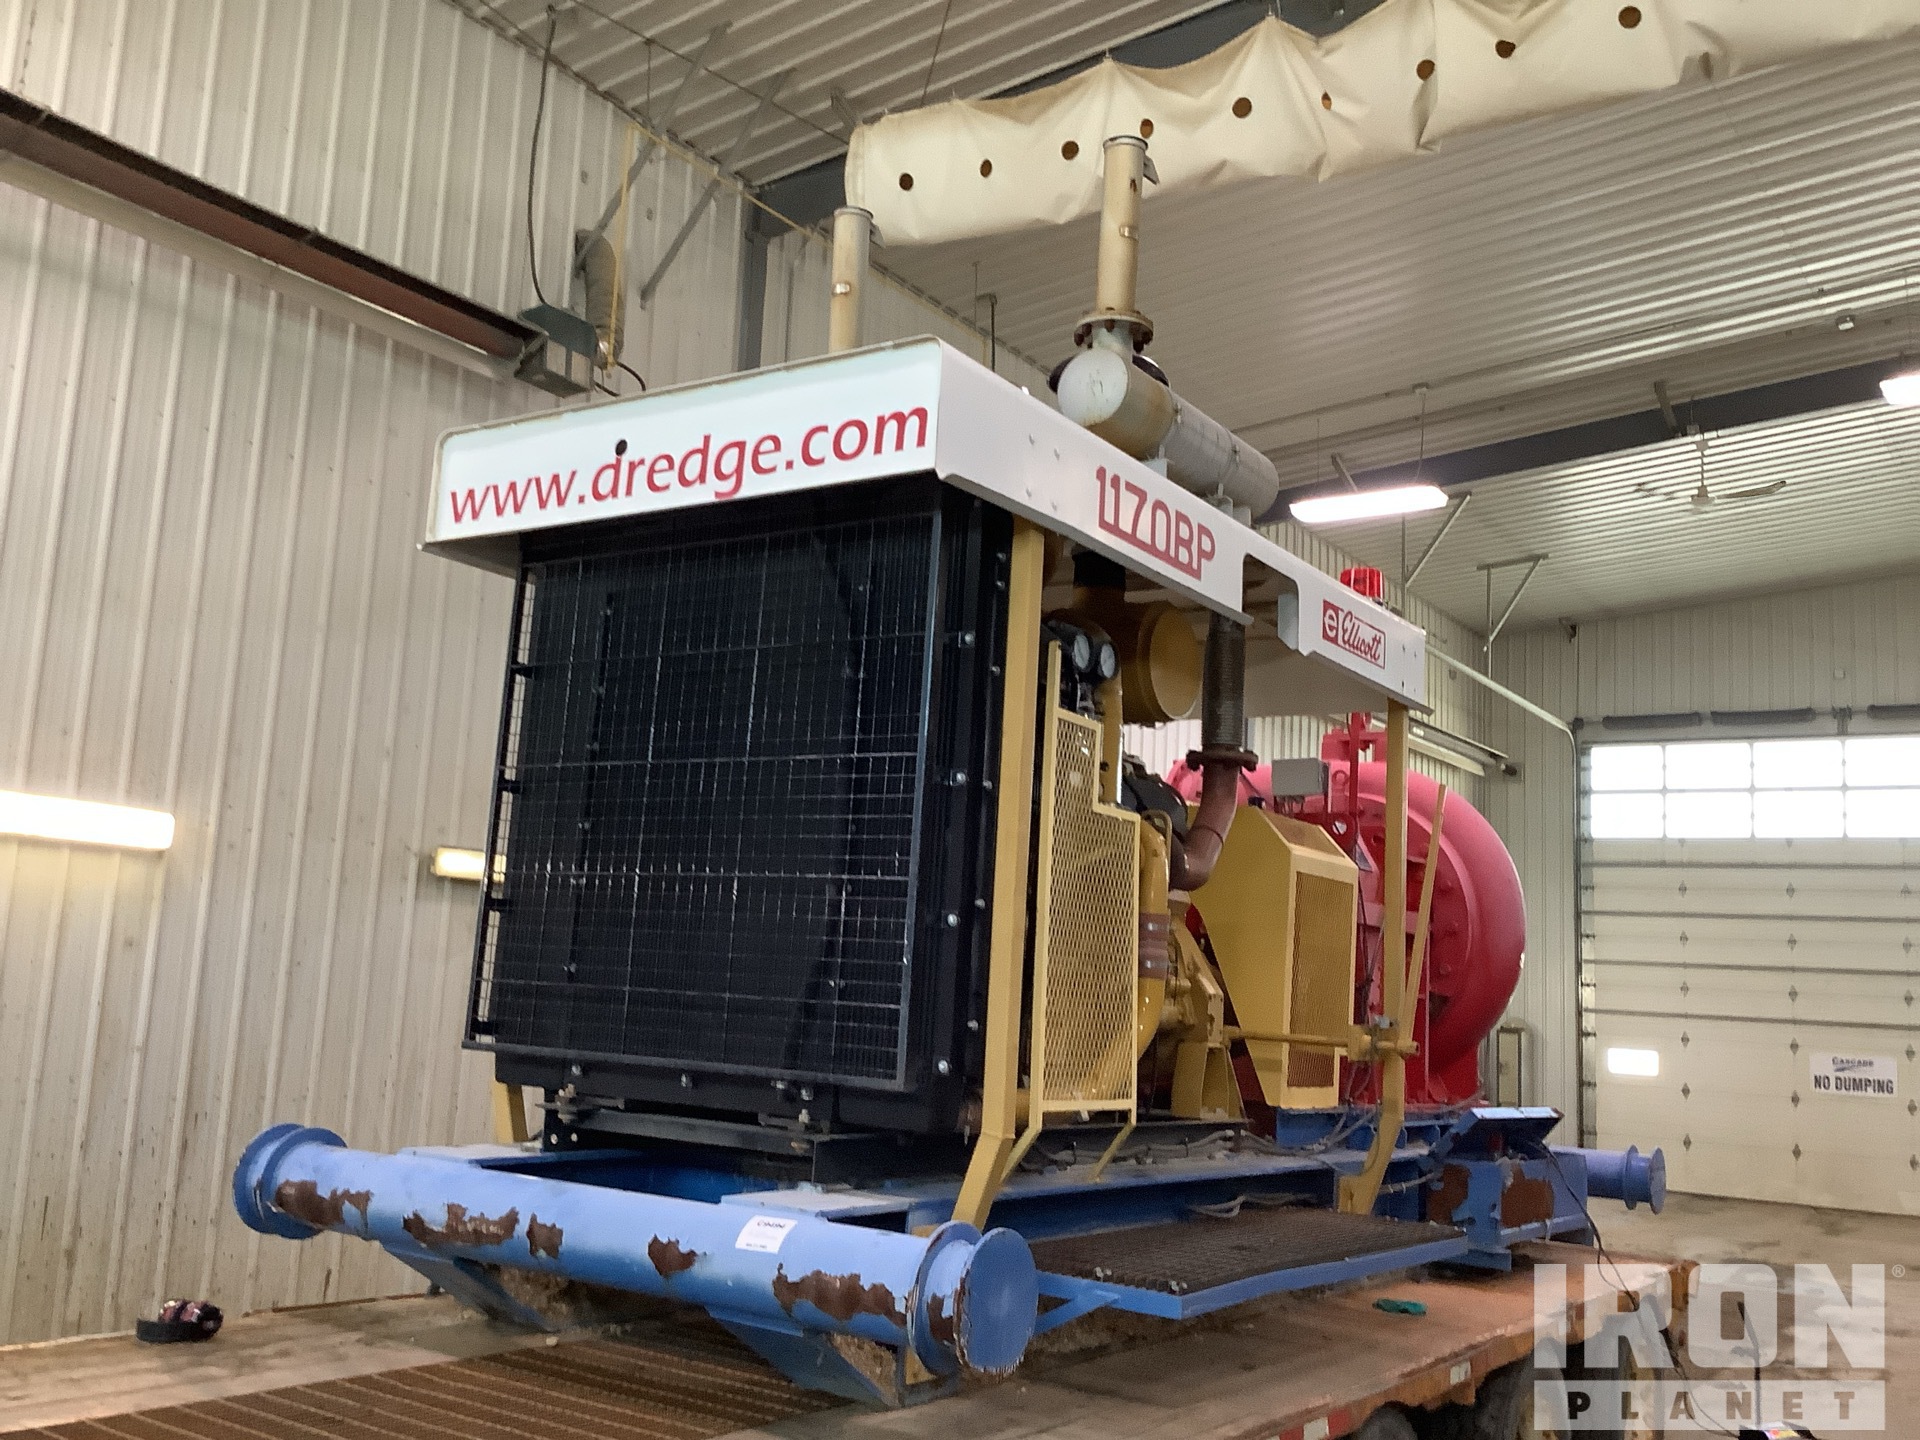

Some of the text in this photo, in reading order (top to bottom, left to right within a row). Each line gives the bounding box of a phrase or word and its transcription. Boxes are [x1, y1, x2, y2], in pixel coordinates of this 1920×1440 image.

[449, 406, 929, 524] www.dredge.com
[1095, 466, 1216, 581] 1170BP
[1341, 610, 1382, 662] Ellicott
[1813, 1075, 1894, 1094] NO DUMPING
